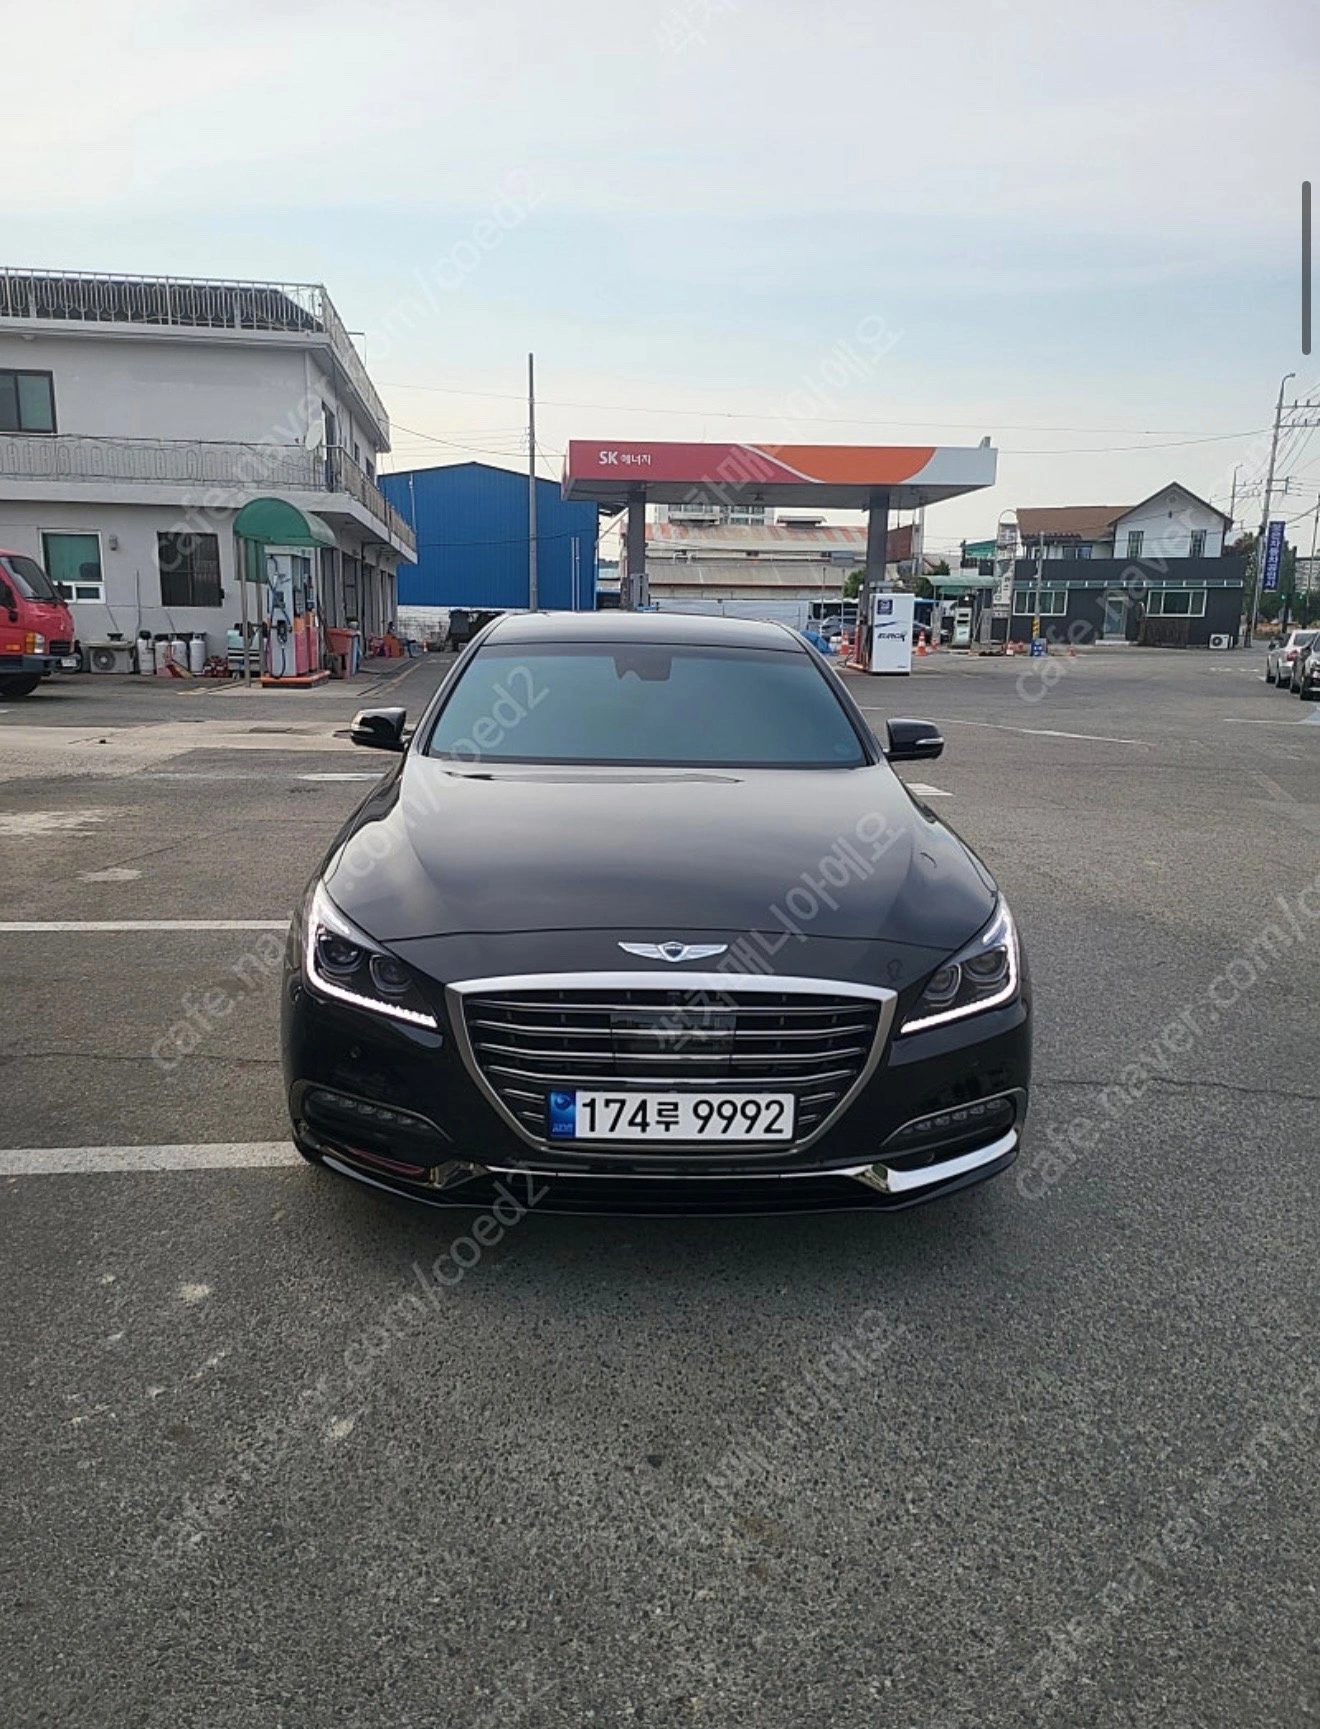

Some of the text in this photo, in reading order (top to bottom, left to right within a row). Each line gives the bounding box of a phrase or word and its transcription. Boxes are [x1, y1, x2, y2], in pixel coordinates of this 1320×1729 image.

[598, 451, 651, 466] SK 에너지
[581, 1097, 785, 1135] 174루 9992
